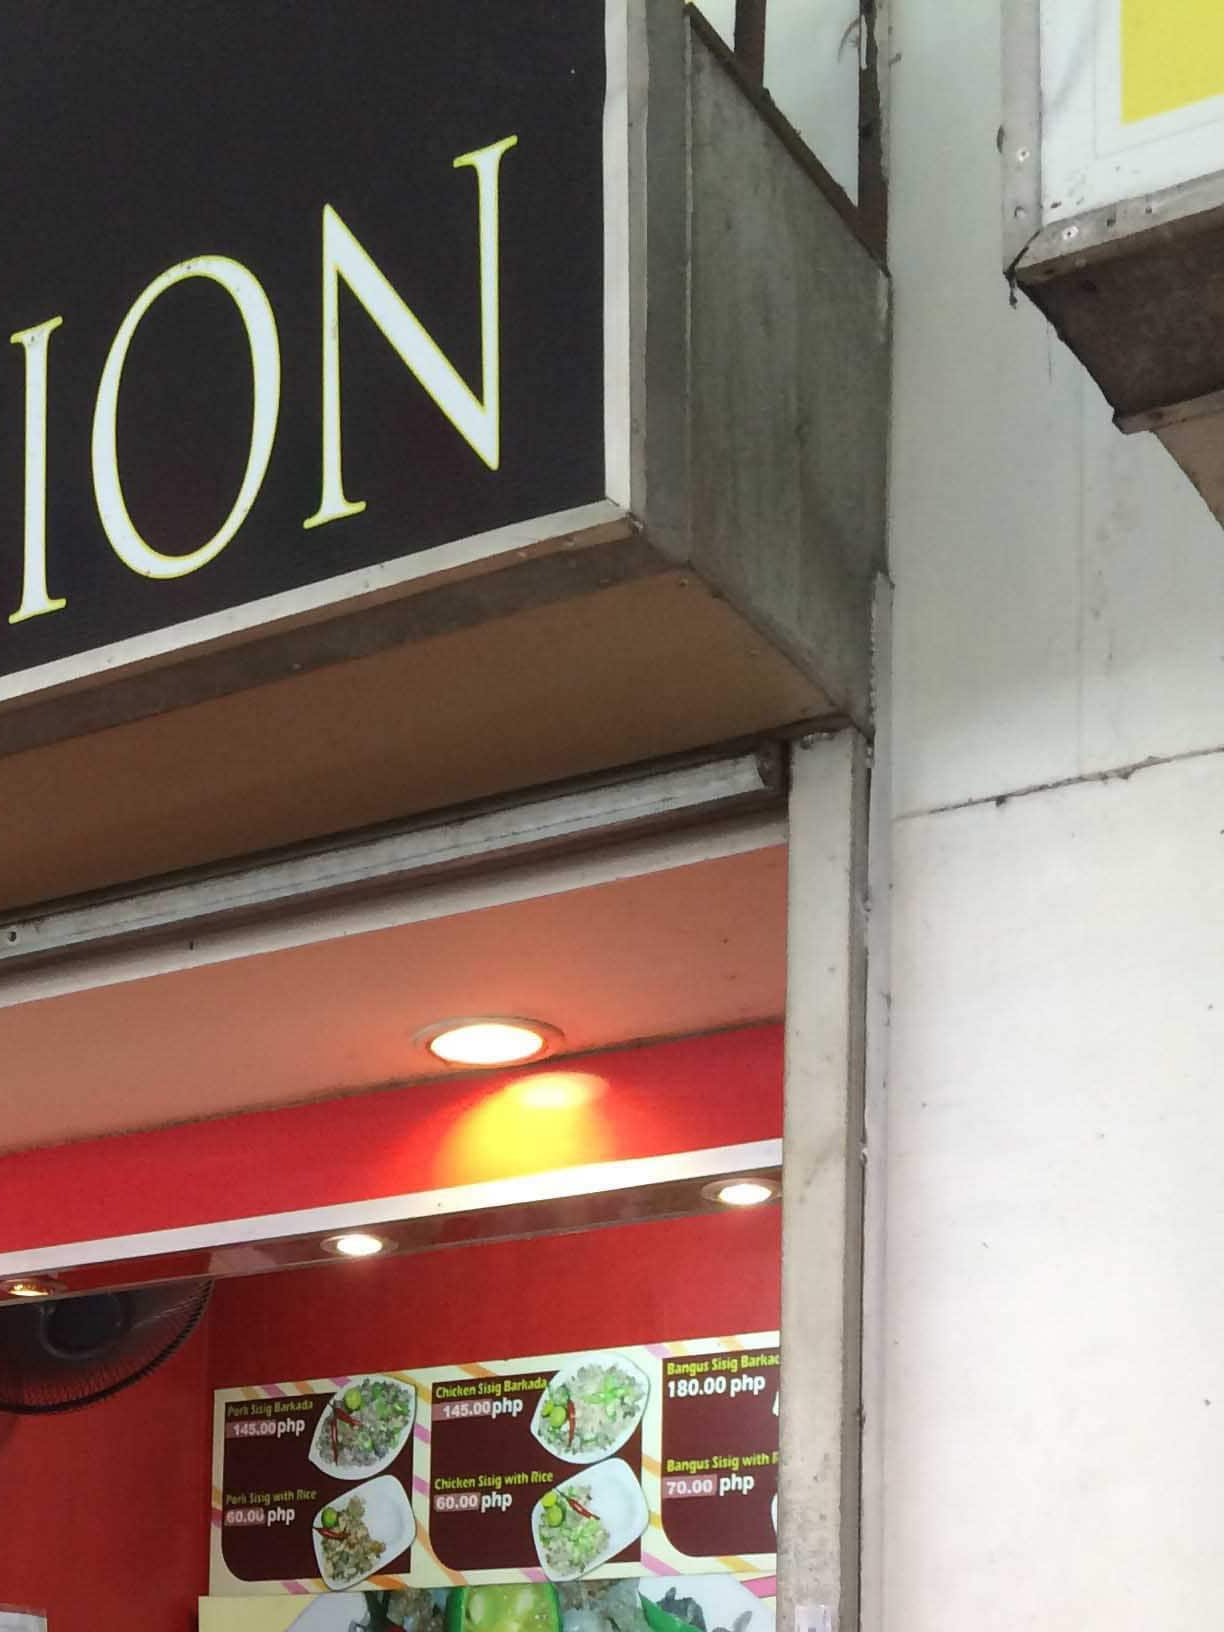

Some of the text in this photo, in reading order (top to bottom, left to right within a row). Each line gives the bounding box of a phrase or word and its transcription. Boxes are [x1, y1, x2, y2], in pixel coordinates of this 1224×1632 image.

[667, 1361, 708, 1376] Bangus
[711, 1357, 738, 1372] Sisig
[436, 1377, 547, 1398] Chicken Sisig Barkada
[667, 1374, 766, 1398] 180.00 php
[227, 1400, 313, 1416] Pork Sisig Barkada
[666, 1458, 709, 1473] Bangus
[712, 1455, 740, 1471] Sisig
[742, 1453, 769, 1466] with
[435, 1471, 553, 1490] Chicken Sisig with Rice
[666, 1473, 754, 1496] 70.00 php
[226, 1489, 317, 1505] Pork Sisig with Rice
[436, 1491, 513, 1513] 60.00 php
[226, 1507, 295, 1527] 60.00 php
